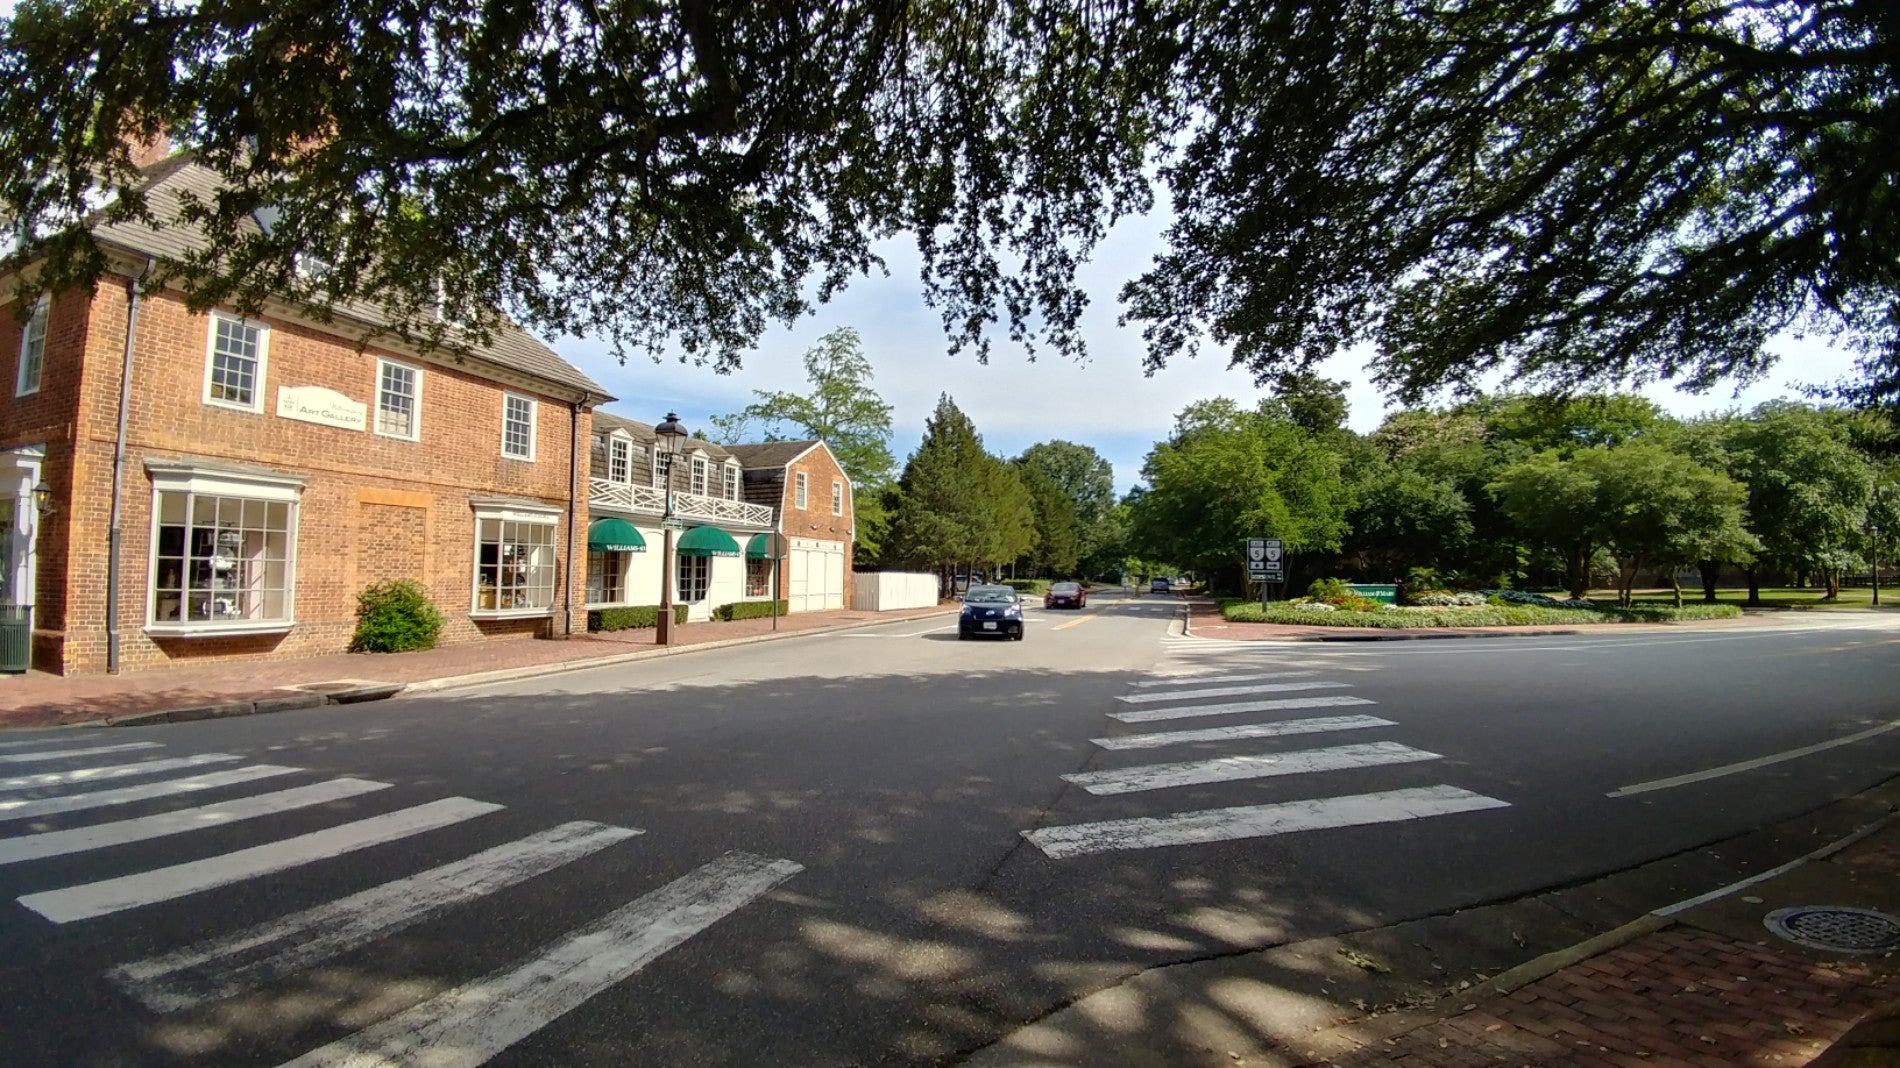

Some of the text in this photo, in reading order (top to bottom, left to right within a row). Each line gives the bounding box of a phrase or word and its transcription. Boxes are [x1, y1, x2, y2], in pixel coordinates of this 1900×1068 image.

[300, 406, 319, 416] ART
[320, 409, 362, 424] GALLERY
[1254, 549, 1260, 558] 5
[1270, 549, 1276, 559] 5
